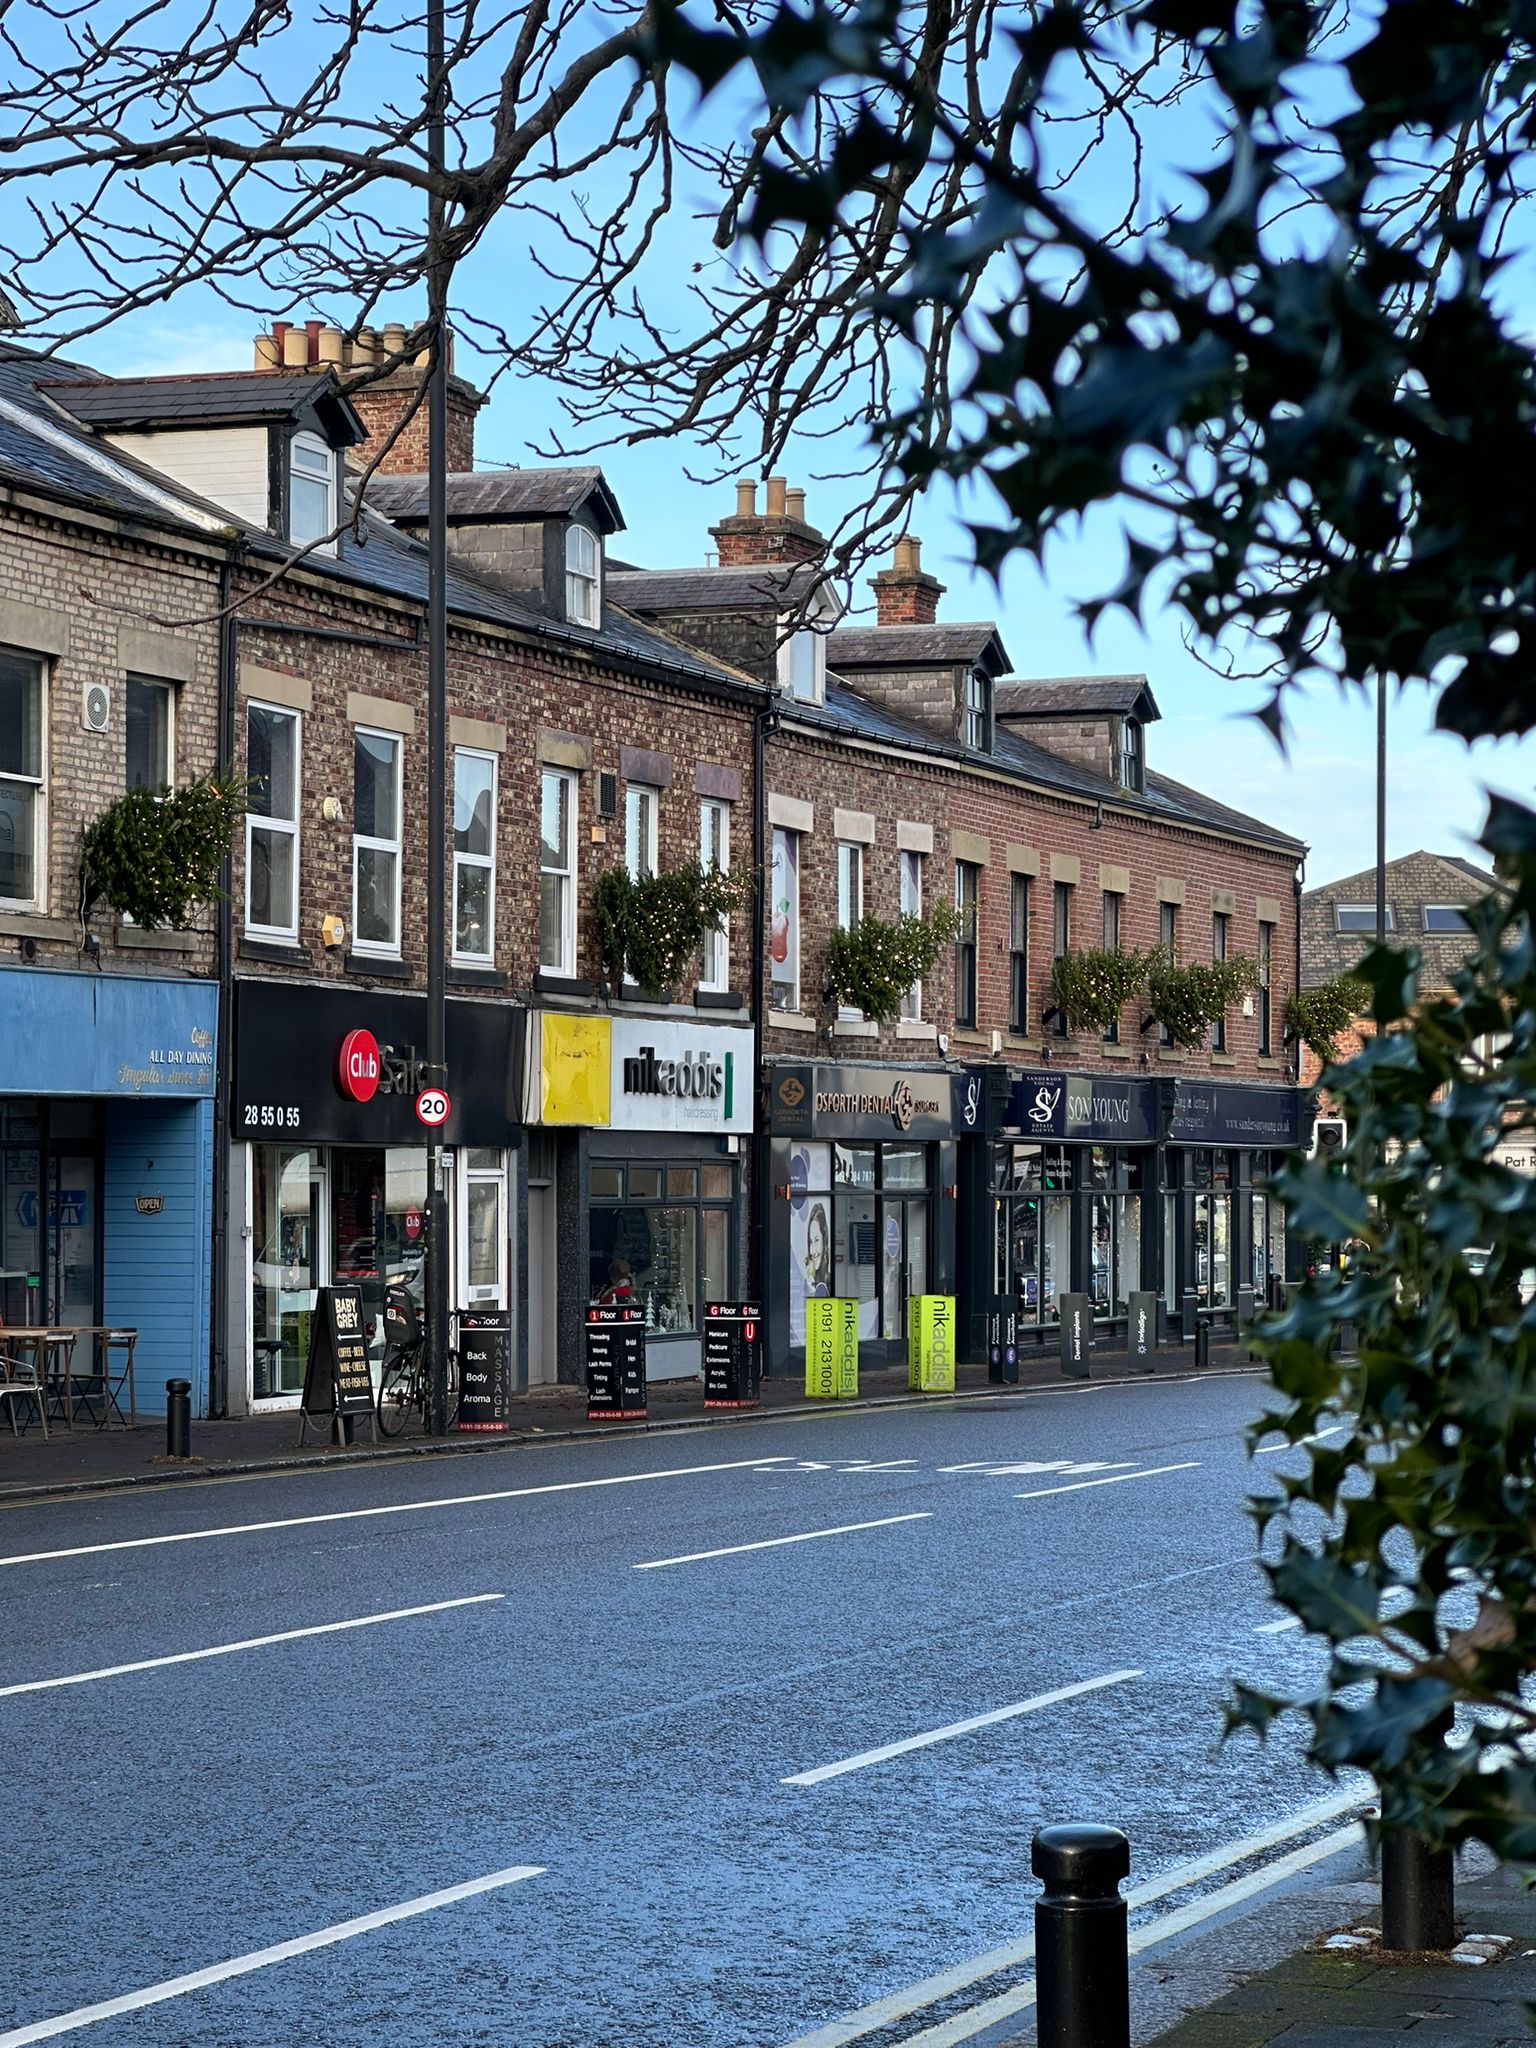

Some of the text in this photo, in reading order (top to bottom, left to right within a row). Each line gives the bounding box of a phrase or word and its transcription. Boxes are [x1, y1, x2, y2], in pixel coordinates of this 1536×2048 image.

[149, 1050, 212, 1066] ALL DAY DINING
[351, 1053, 376, 1078] Club
[624, 1046, 723, 1098] nikaddis
[422, 1100, 445, 1114] 20
[861, 1095, 895, 1114] DENTAL
[1093, 1098, 1129, 1123] YOUNG
[245, 1105, 300, 1127] 28 55 0 55
[1505, 1156, 1526, 1167] Pat
[139, 1199, 160, 1209] OPEN
[335, 1297, 356, 1313] BABY
[711, 1306, 736, 1315] G Floor
[742, 1306, 759, 1315] G Floor
[336, 1313, 358, 1329] GREY
[600, 1311, 616, 1319] Floor
[630, 1310, 642, 1318] Floor
[746, 1323, 754, 1339] U
[821, 1303, 833, 1393] 0191 2131001
[844, 1302, 856, 1389] nikaddis
[932, 1300, 950, 1382] nikaddis
[467, 1351, 487, 1360] Back
[466, 1373, 488, 1383] Body
[493, 1336, 503, 1417] MASSAGE
[463, 1394, 491, 1403] Aroma
